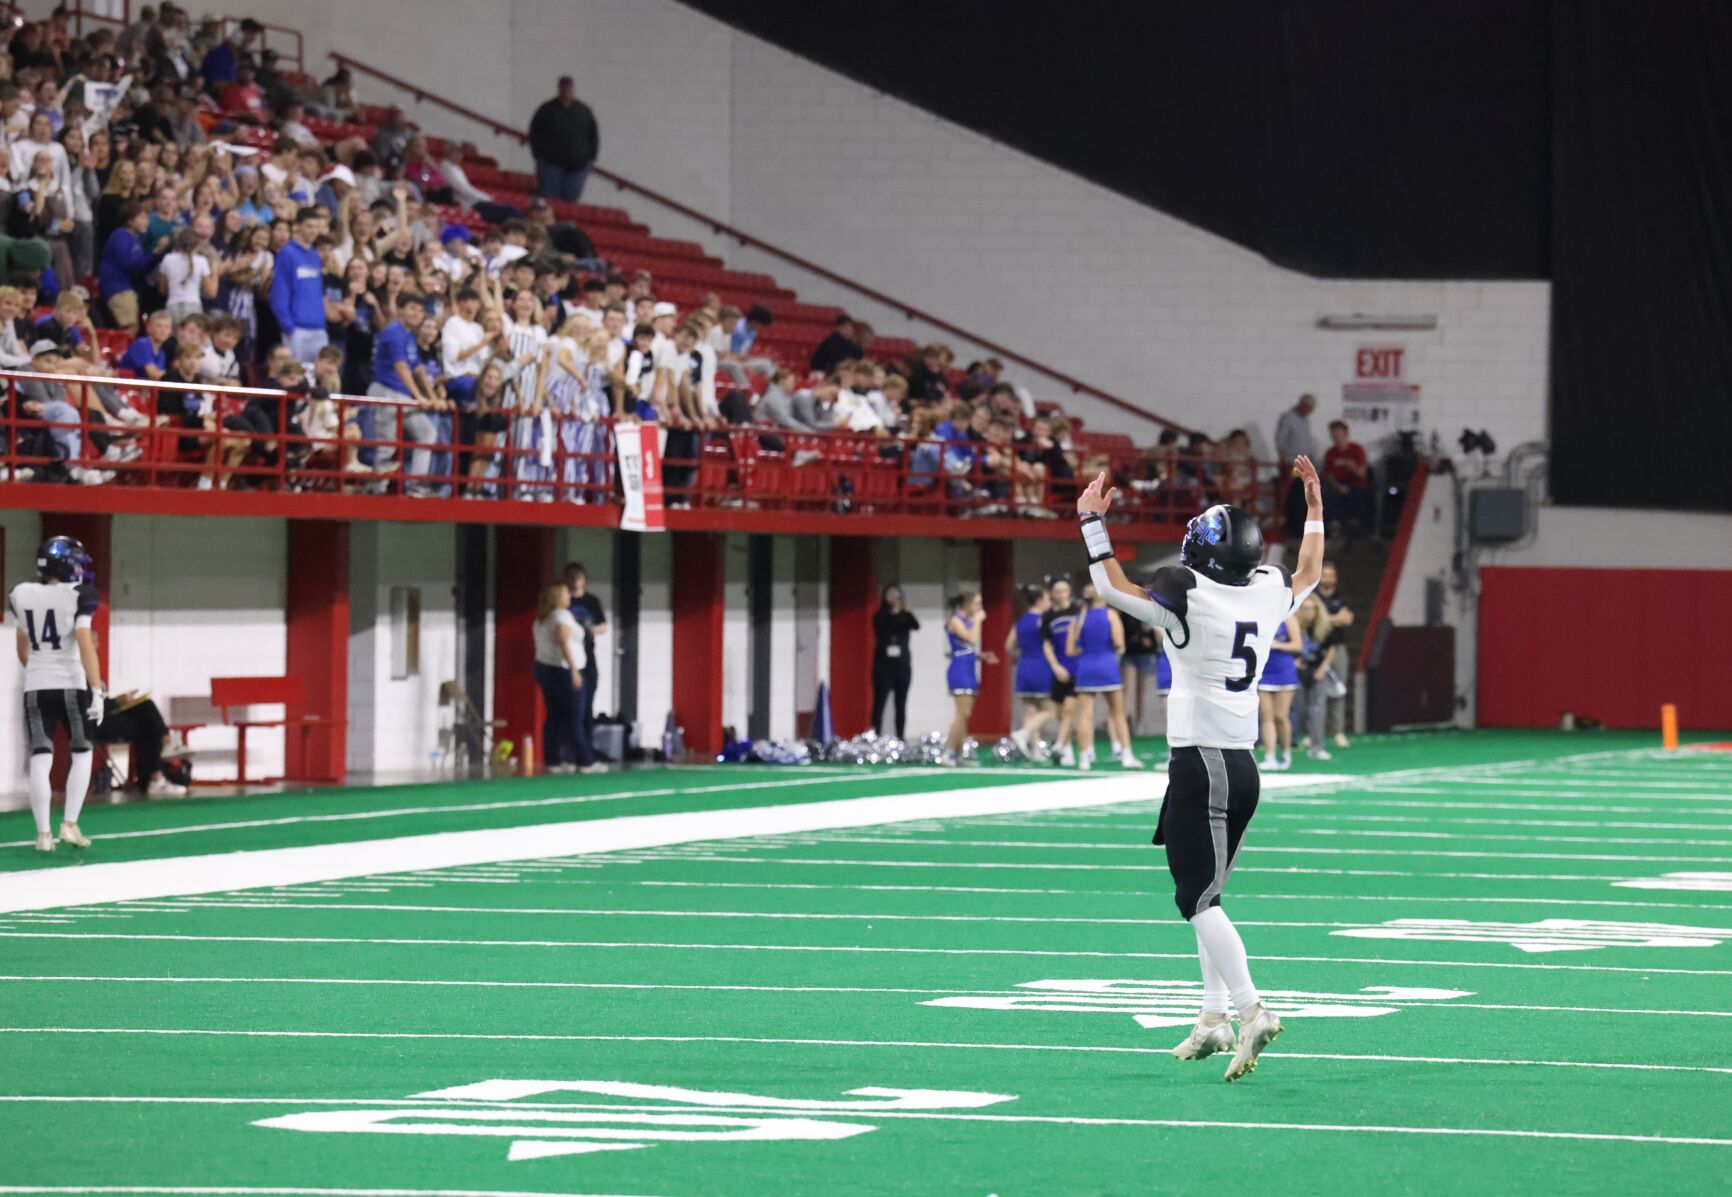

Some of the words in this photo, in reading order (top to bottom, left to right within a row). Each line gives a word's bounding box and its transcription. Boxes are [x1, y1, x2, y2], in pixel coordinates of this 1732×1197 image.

[1357, 348, 1403, 378] EXIT
[25, 608, 61, 651] 14
[1225, 621, 1259, 692] 5
